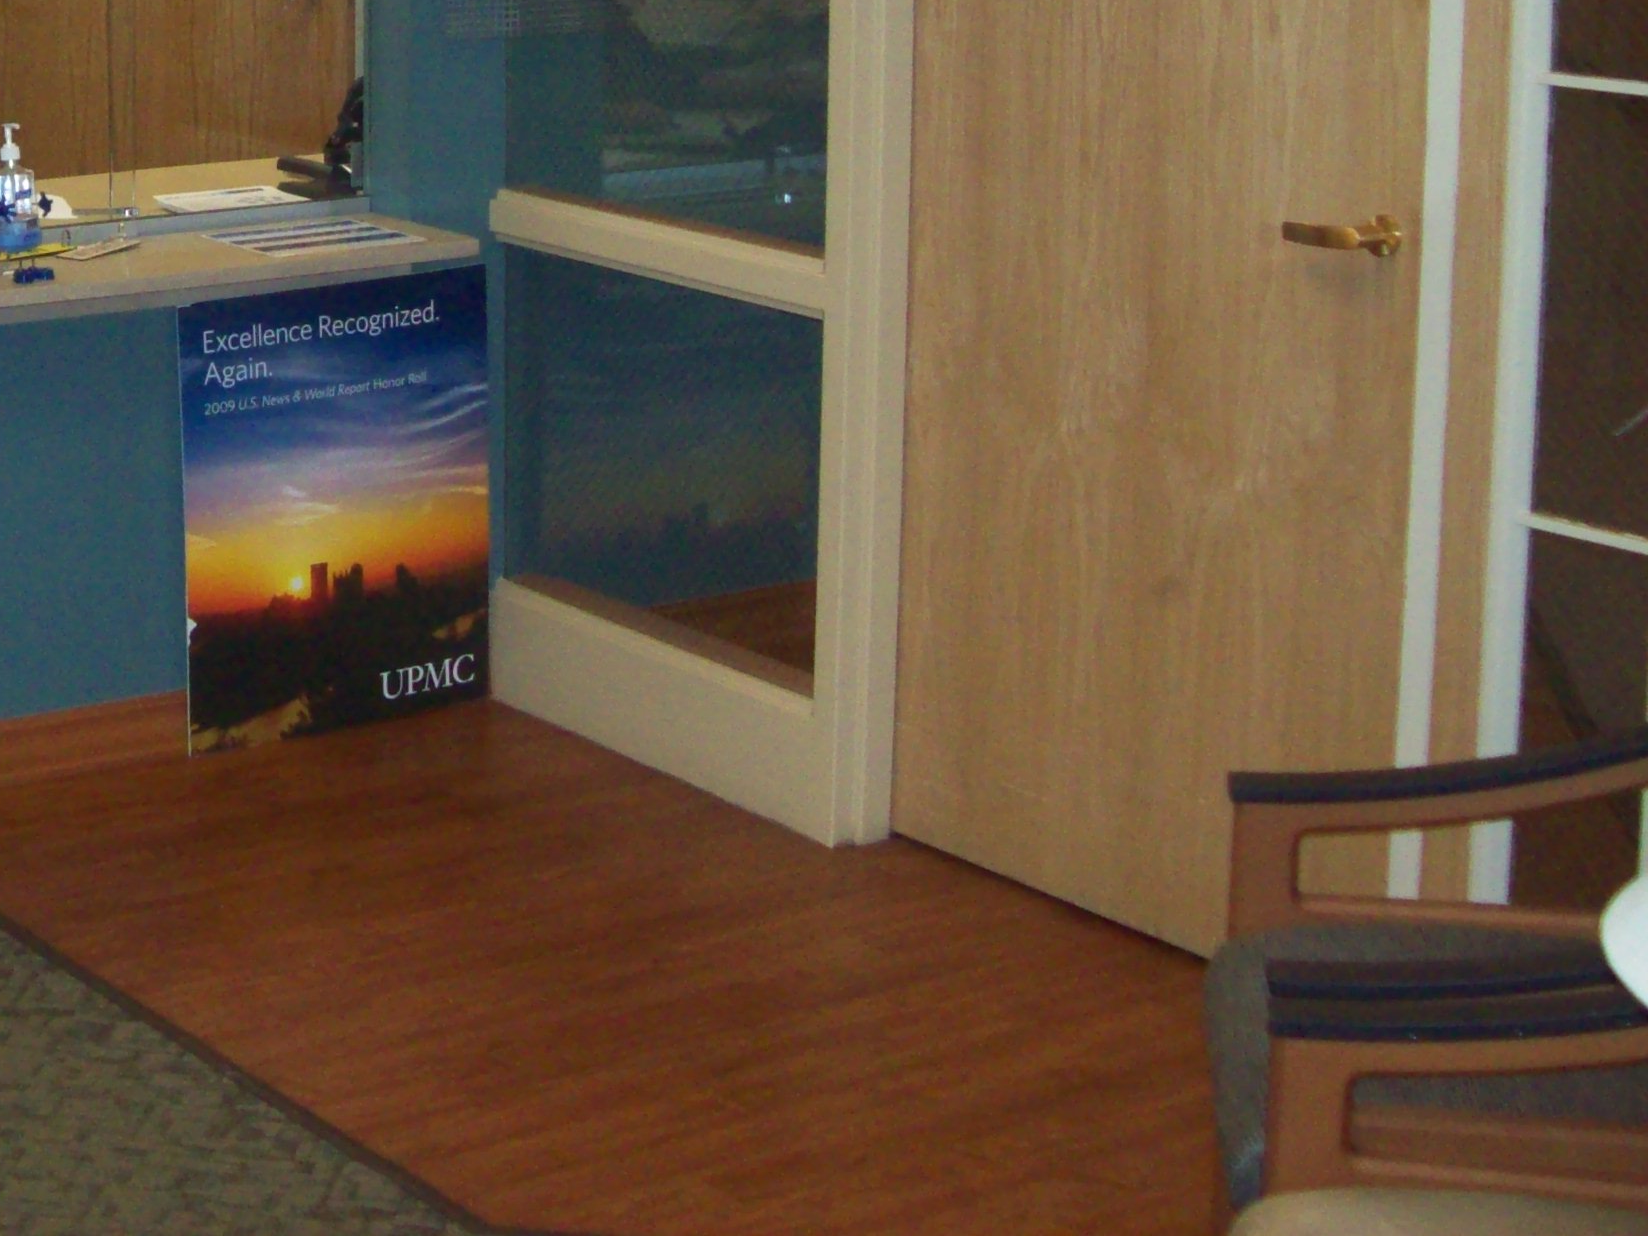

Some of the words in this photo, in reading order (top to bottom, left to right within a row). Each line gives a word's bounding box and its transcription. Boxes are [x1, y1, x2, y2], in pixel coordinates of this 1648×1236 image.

[202, 322, 313, 355] Excellence
[318, 299, 441, 339] Recognized.
[203, 357, 274, 389] Again.
[204, 398, 236, 416] 2009
[238, 397, 258, 411] U.S.
[261, 393, 291, 408] News
[292, 390, 302, 403] &
[304, 386, 336, 401] World
[338, 381, 371, 399] Report
[372, 375, 405, 391] Honor
[407, 370, 428, 386] Roll
[379, 653, 475, 700] UPMC
